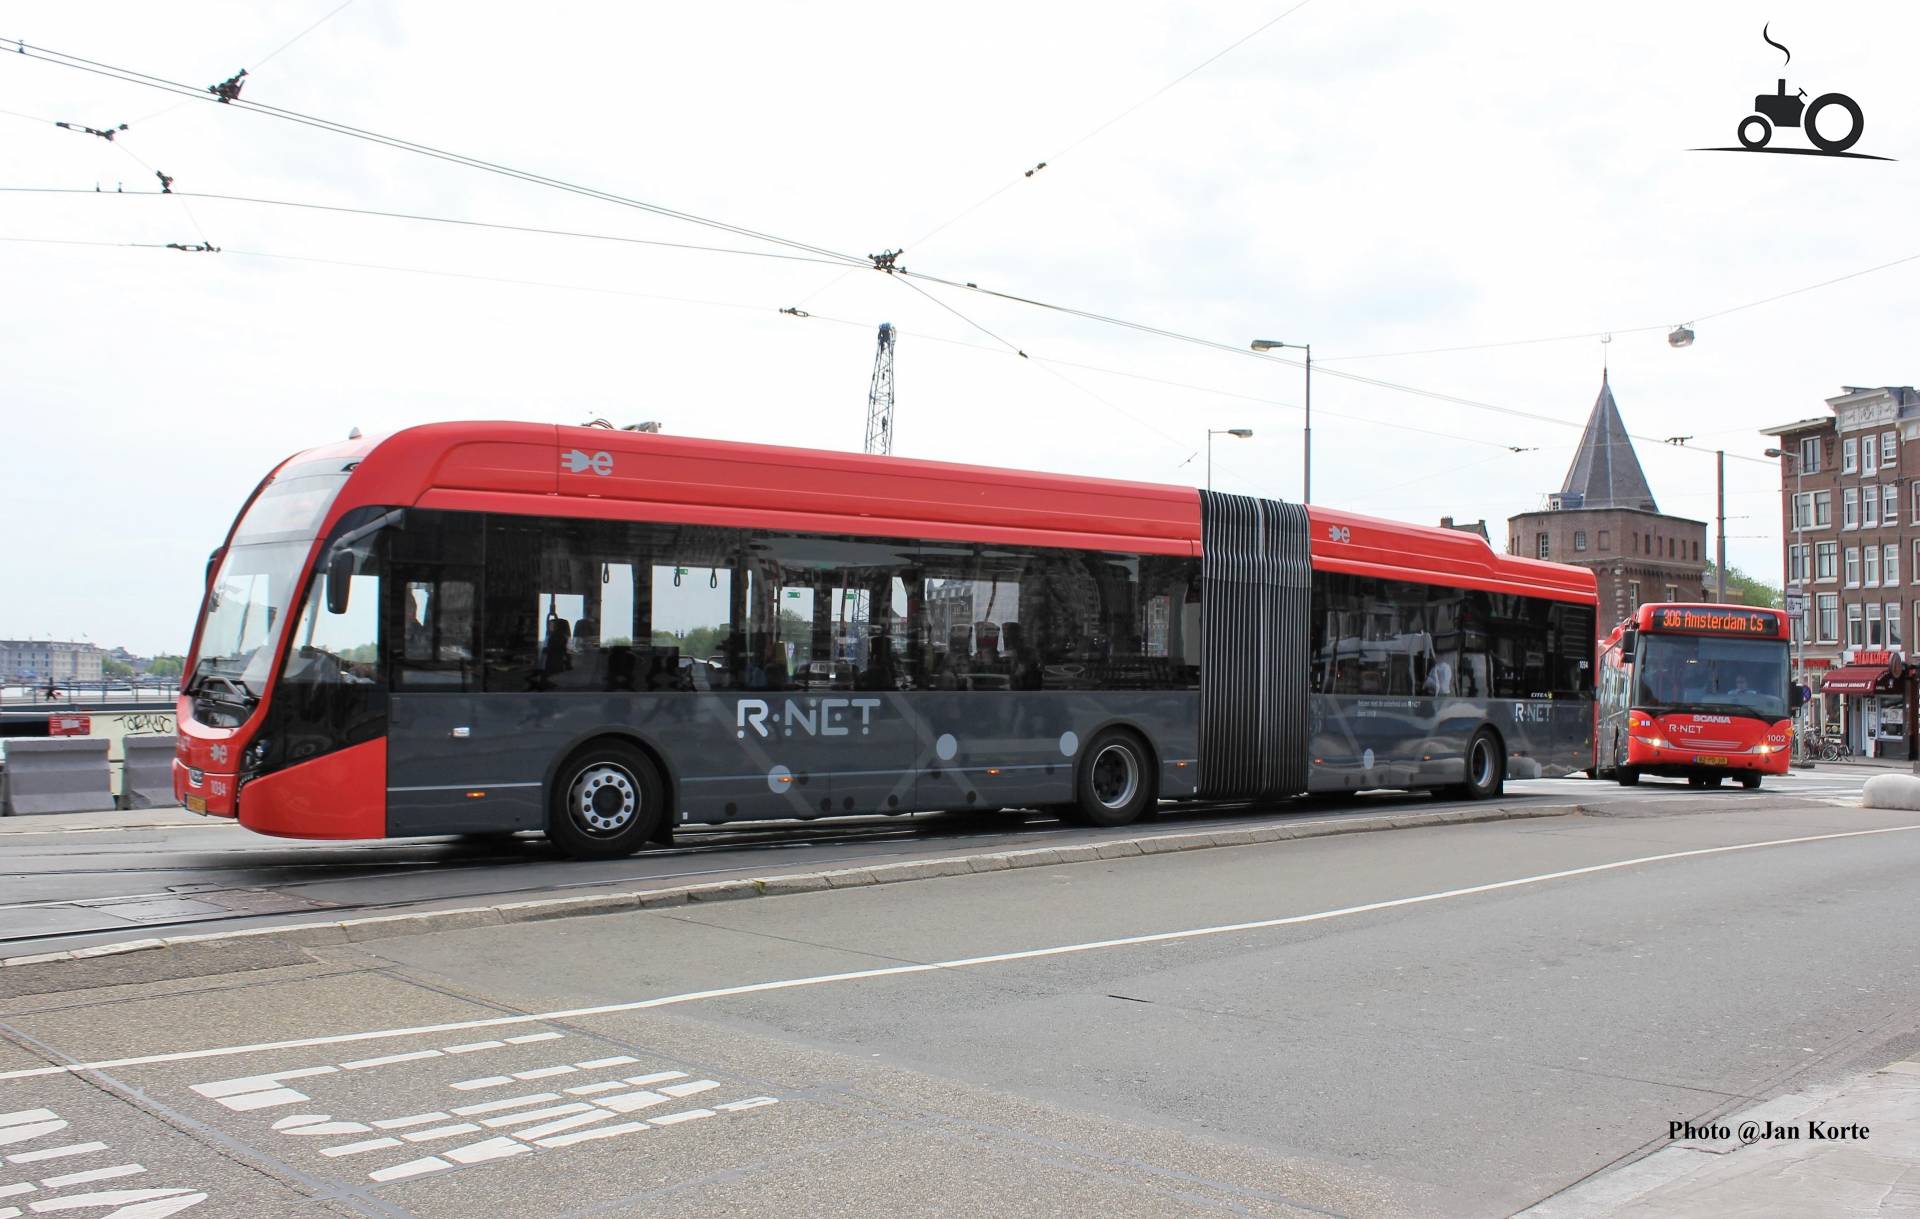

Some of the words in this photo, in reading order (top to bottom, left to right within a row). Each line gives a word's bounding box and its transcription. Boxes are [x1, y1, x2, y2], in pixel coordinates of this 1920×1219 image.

[1663, 609, 1682, 627] 306
[1684, 611, 1746, 631] Amsterdam
[1750, 614, 1764, 631] Cs
[1692, 714, 1731, 724] SCANIA
